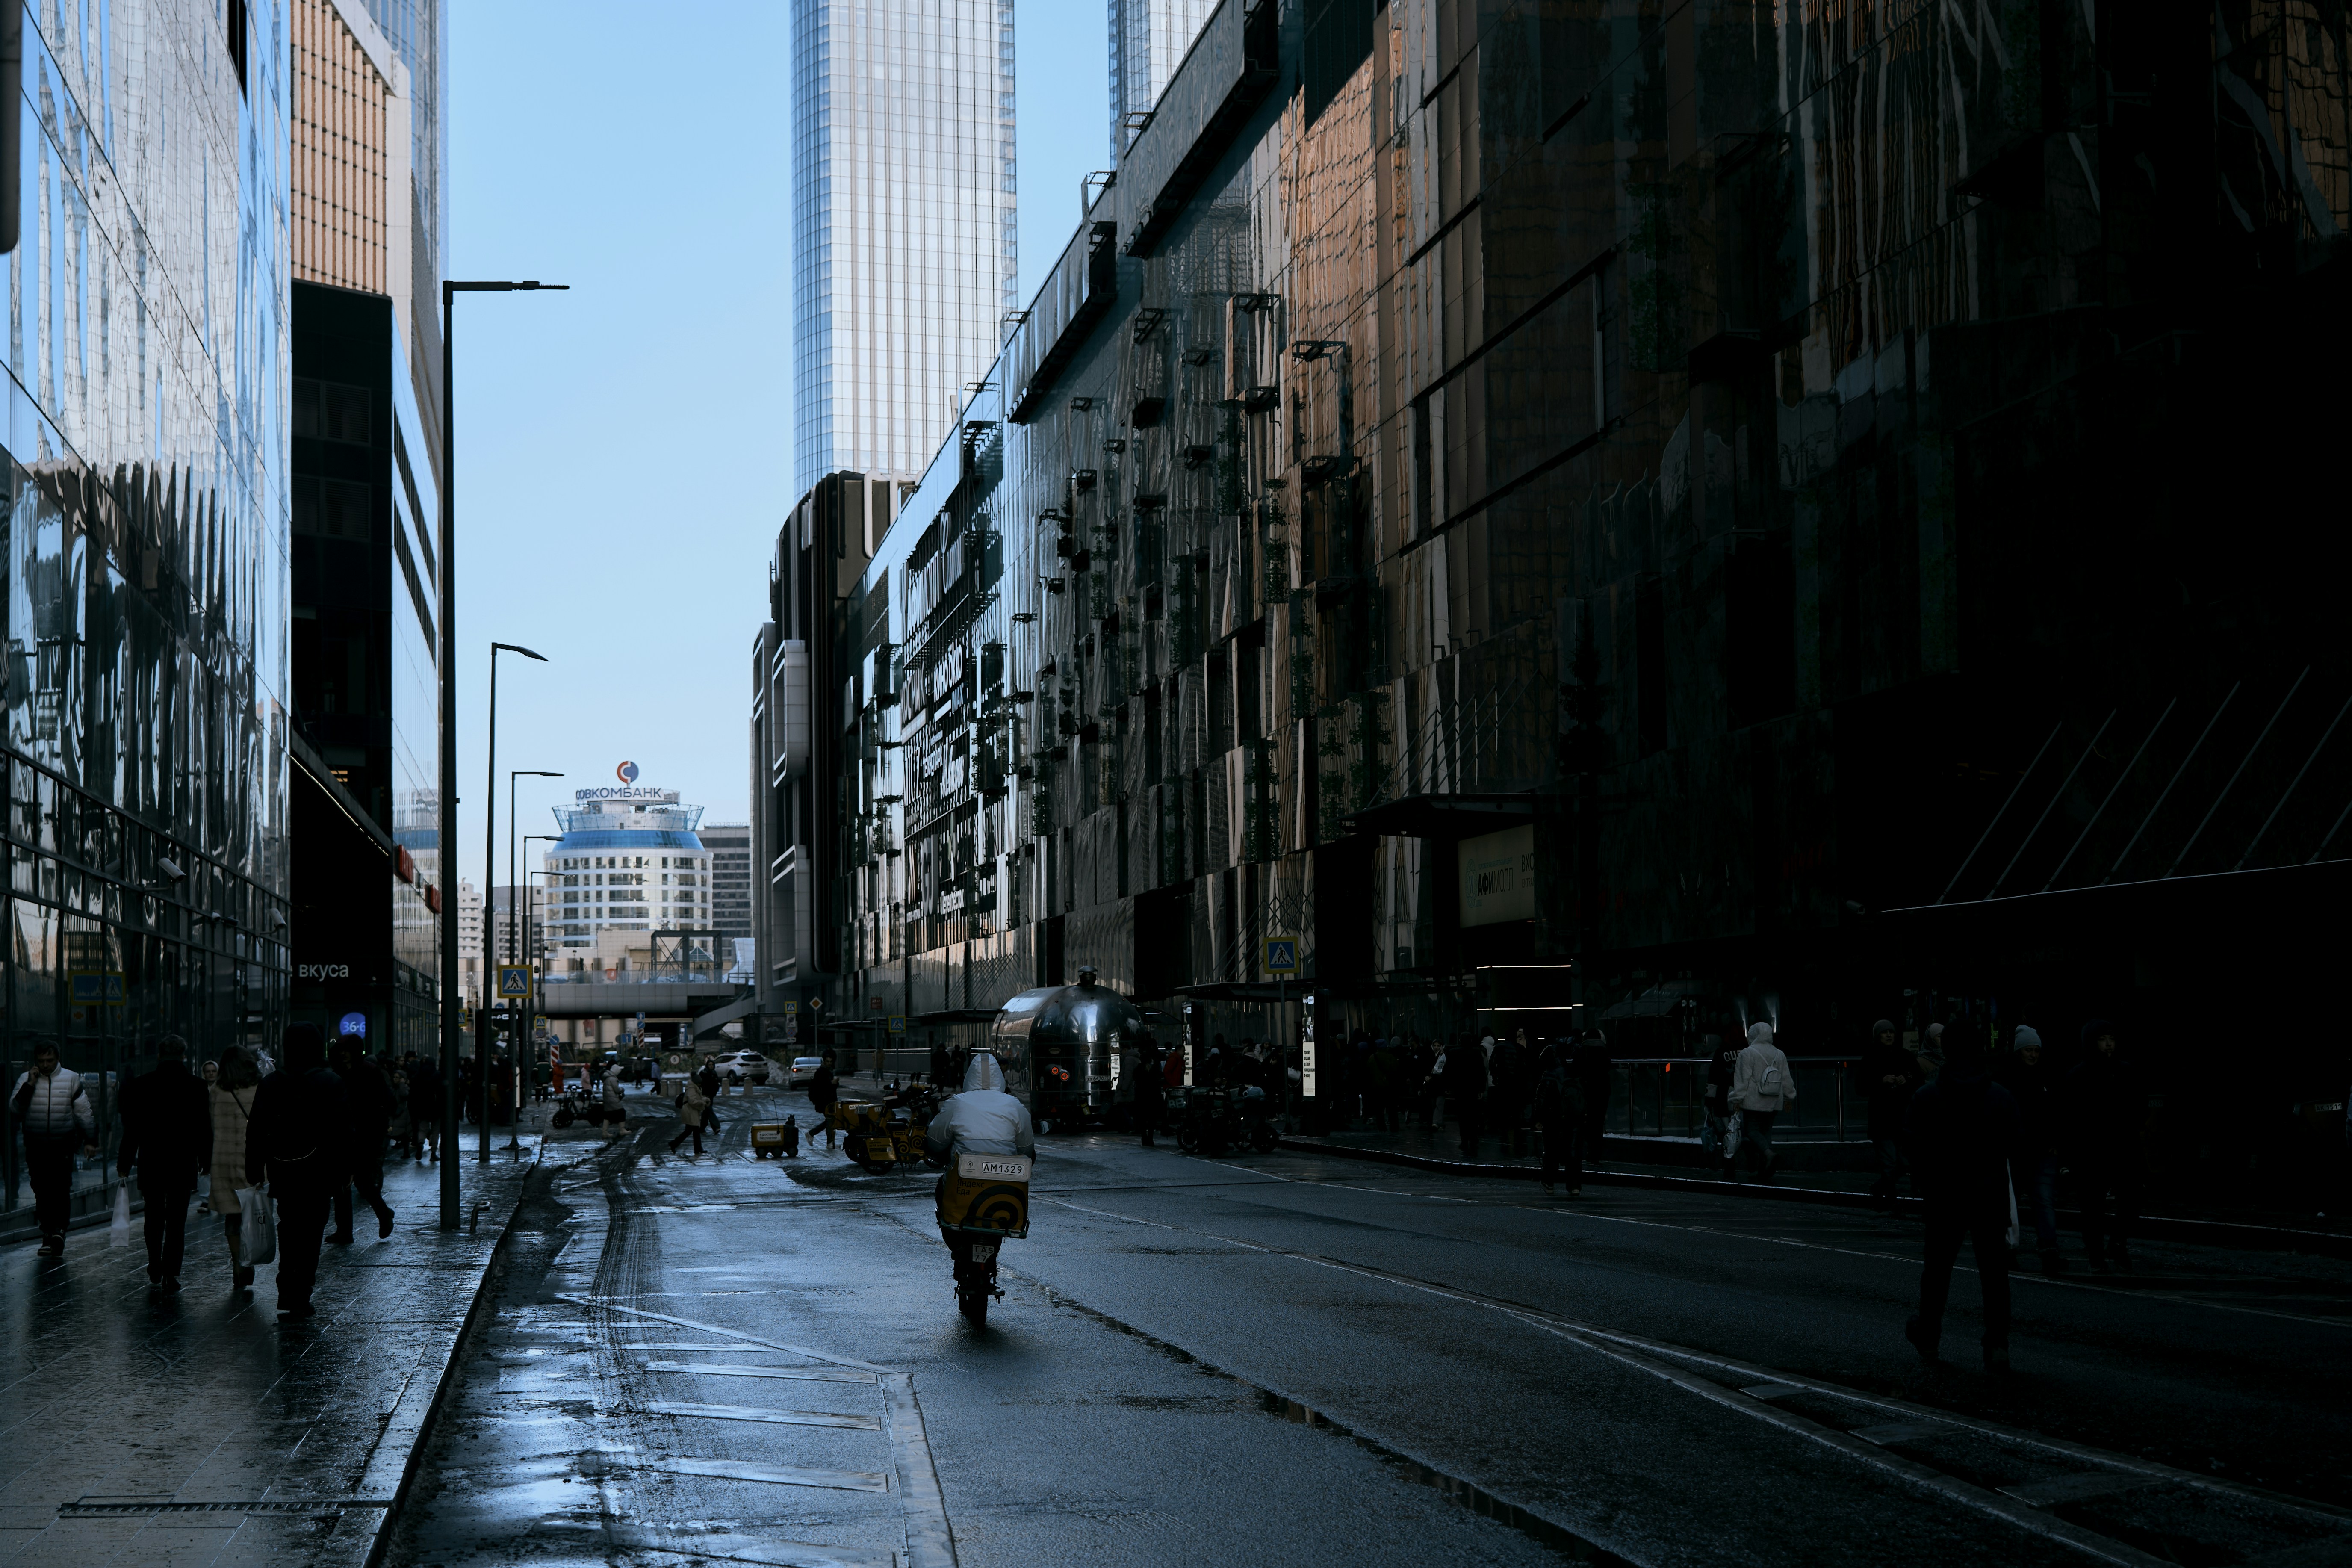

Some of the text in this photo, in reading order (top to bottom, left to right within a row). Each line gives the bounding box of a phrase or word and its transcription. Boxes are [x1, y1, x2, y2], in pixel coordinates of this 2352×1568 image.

[576, 788, 661, 800] СОВКОМБАНК
[1477, 867, 1514, 897] АФИМОЛЛ
[298, 964, 349, 982] вкуса
[983, 1163, 1022, 1174] AM1329
[957, 1178, 985, 1188] Яндекс
[956, 1186, 970, 1196] Еда
